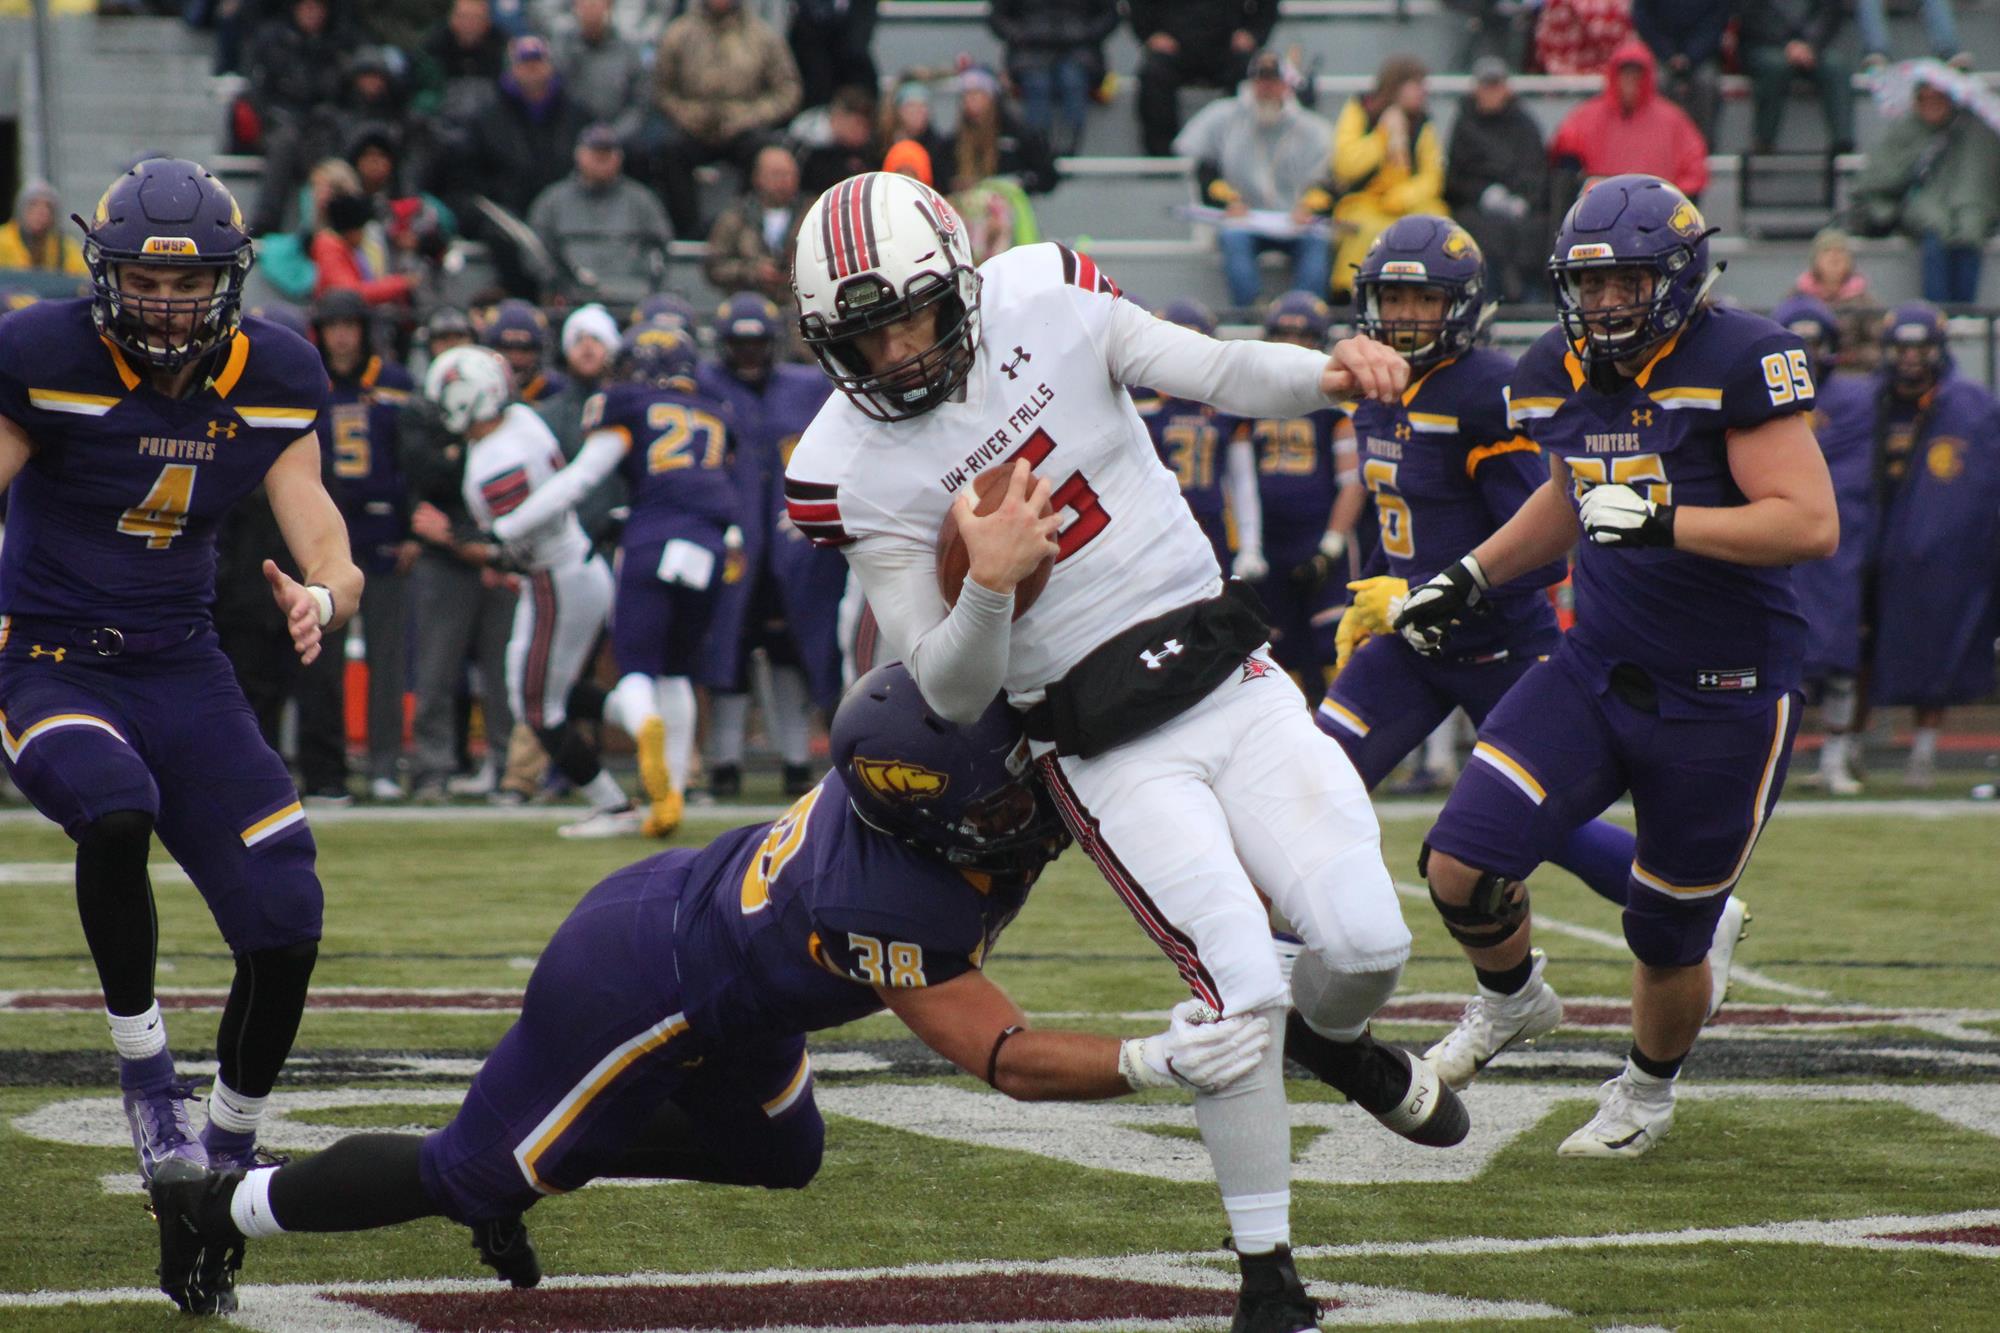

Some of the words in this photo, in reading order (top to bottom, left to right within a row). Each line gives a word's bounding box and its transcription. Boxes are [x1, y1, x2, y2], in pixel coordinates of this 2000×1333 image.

[153, 240, 187, 252] UWSP
[1761, 349, 1815, 406] 95
[138, 436, 216, 461] POINTERS
[331, 416, 373, 478] 5
[647, 402, 726, 476] 27
[940, 428, 1012, 494] UW-RIVER
[1008, 382, 1055, 434] FALLS
[1584, 432, 1640, 453] POINTERS
[116, 463, 198, 550] 4
[847, 931, 928, 988] 38
